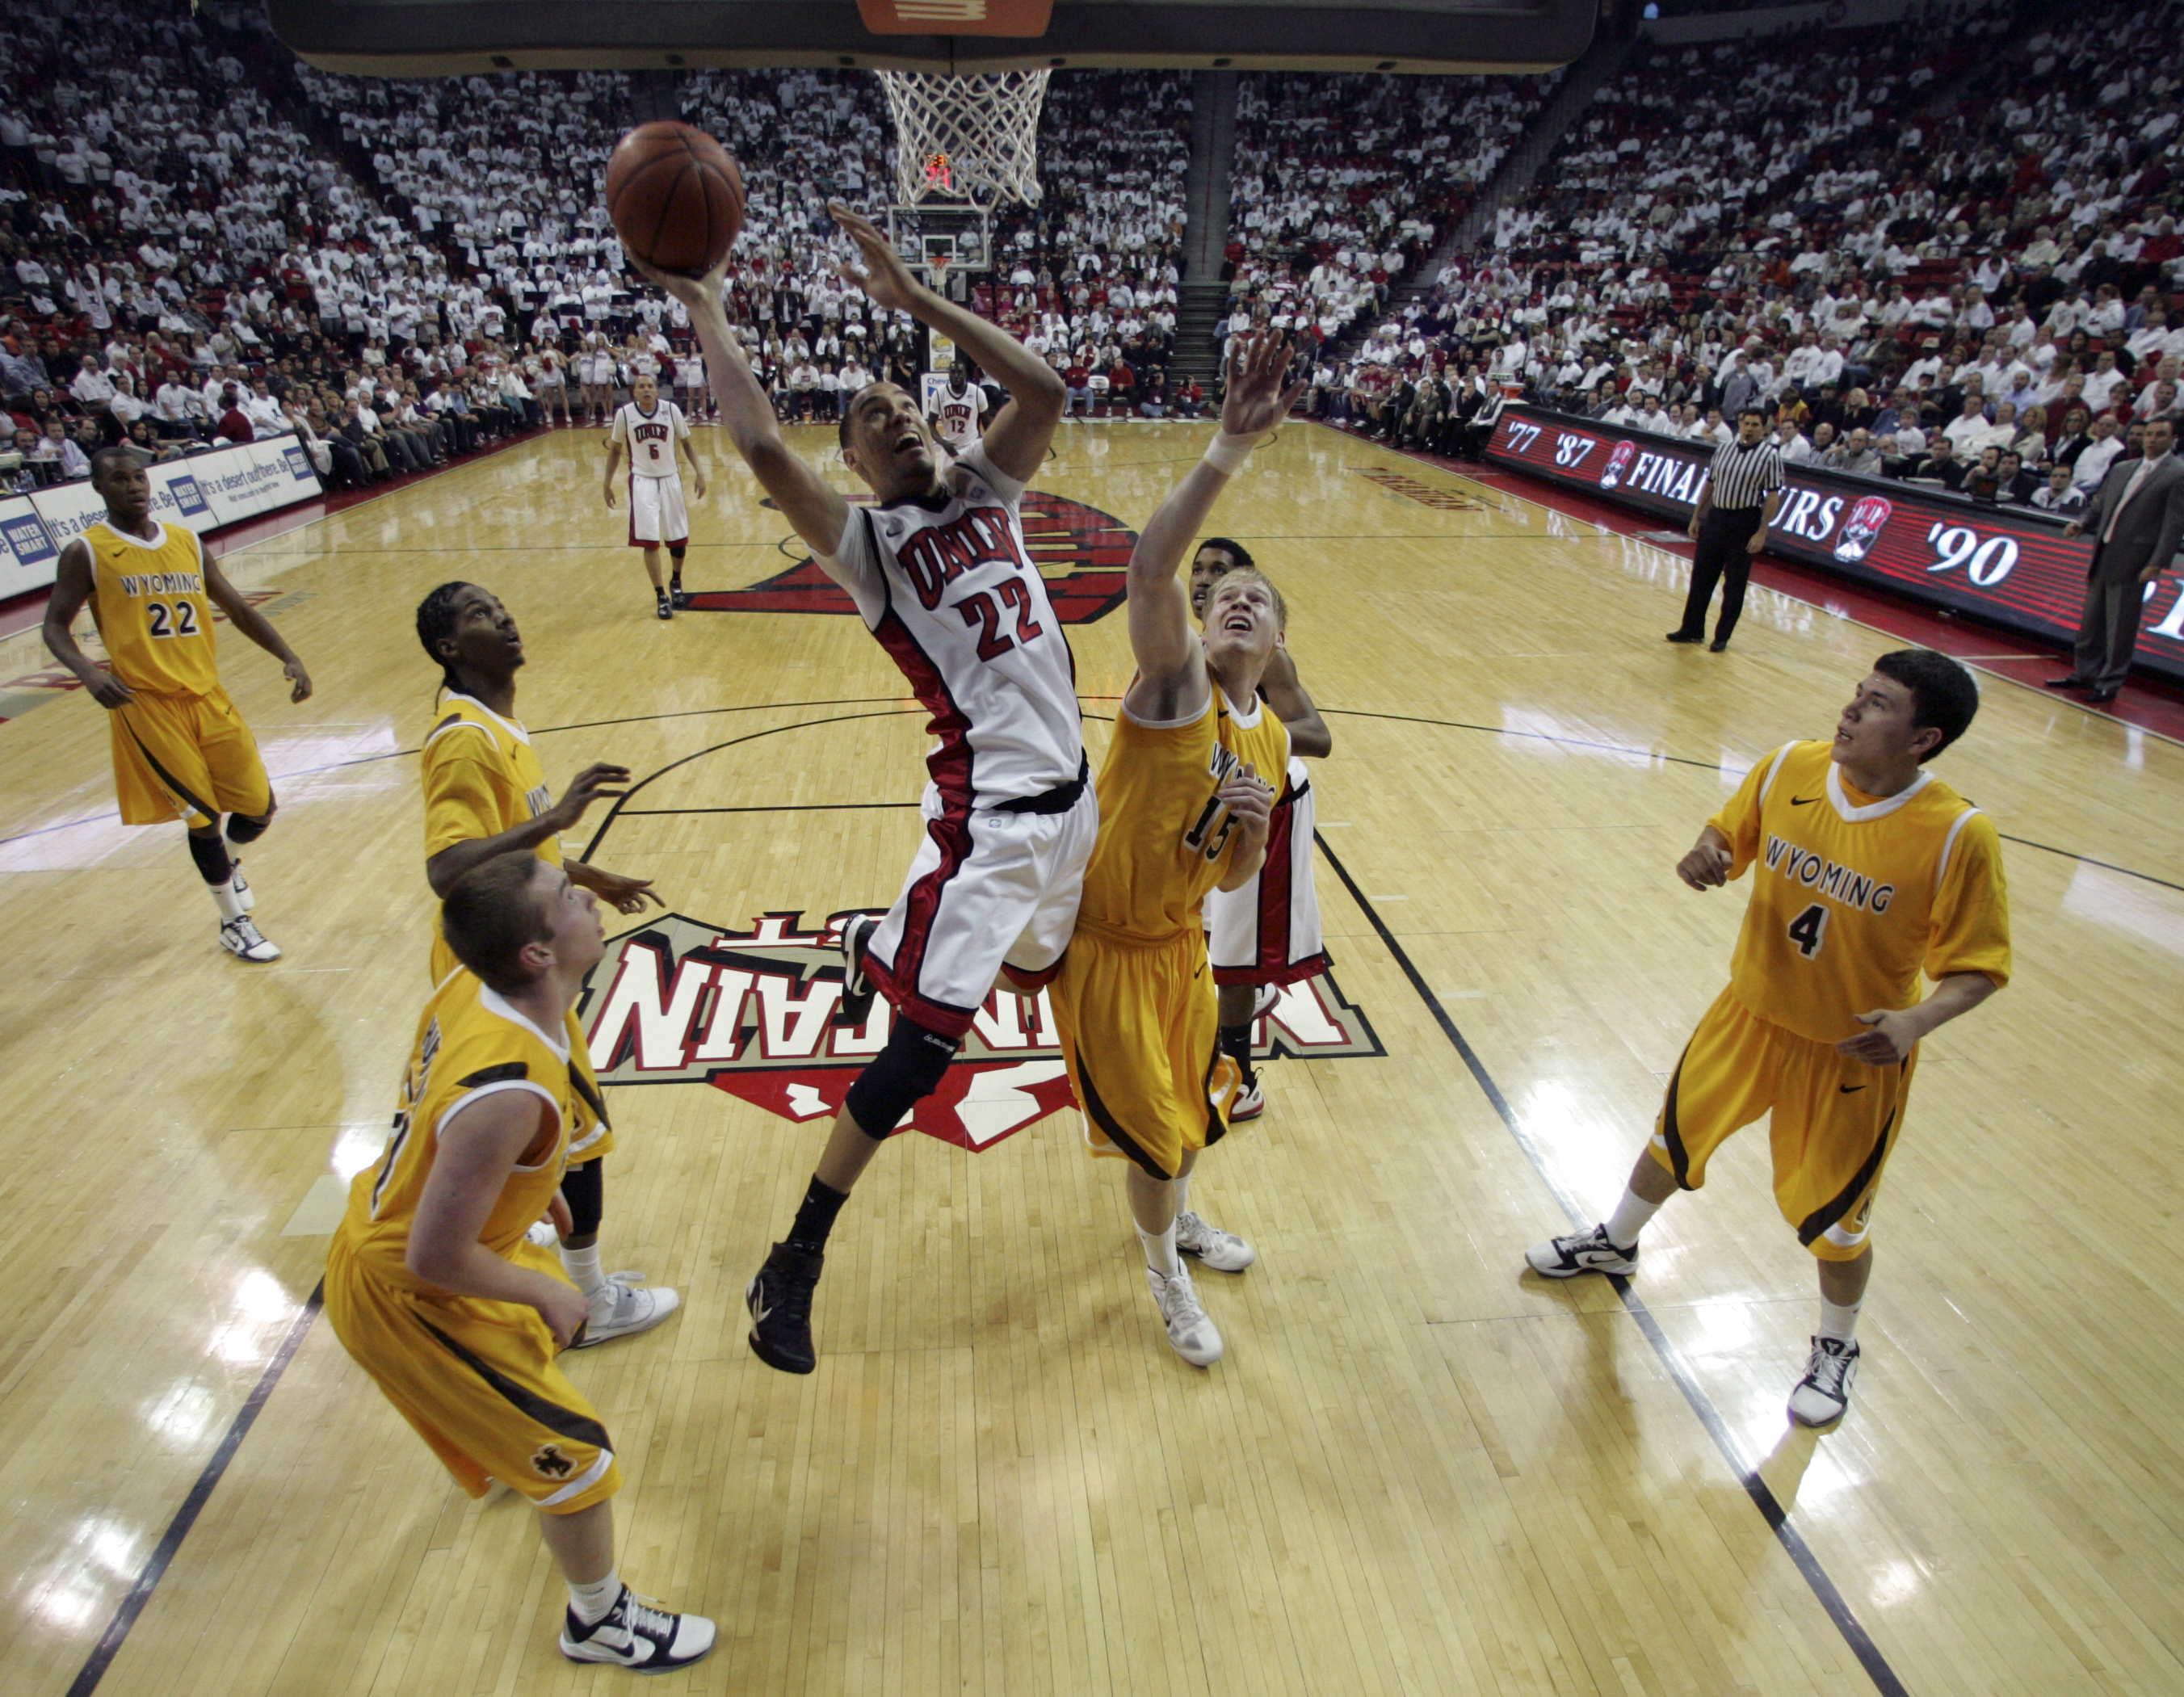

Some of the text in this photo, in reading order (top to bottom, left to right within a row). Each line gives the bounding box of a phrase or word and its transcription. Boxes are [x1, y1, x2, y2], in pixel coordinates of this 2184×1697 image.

[634, 423, 669, 443] UNLV
[944, 404, 972, 420] UNLV
[951, 419, 965, 434] 12
[47, 518, 71, 539] It's
[69, 519, 82, 533] a
[158, 491, 175, 508] Be
[1507, 421, 1541, 453] '77
[1555, 433, 1596, 468] '87
[1926, 522, 2018, 586] '90
[6, 523, 43, 543] WATER
[15, 536, 49, 556] SMART
[896, 506, 1023, 611] UNLV
[120, 572, 203, 597] WYOMING
[147, 600, 201, 639] 22
[949, 576, 1044, 662] 22
[1184, 795, 1241, 864] 15
[1765, 833, 1895, 915] WYOMING
[1787, 902, 1829, 961] 4
